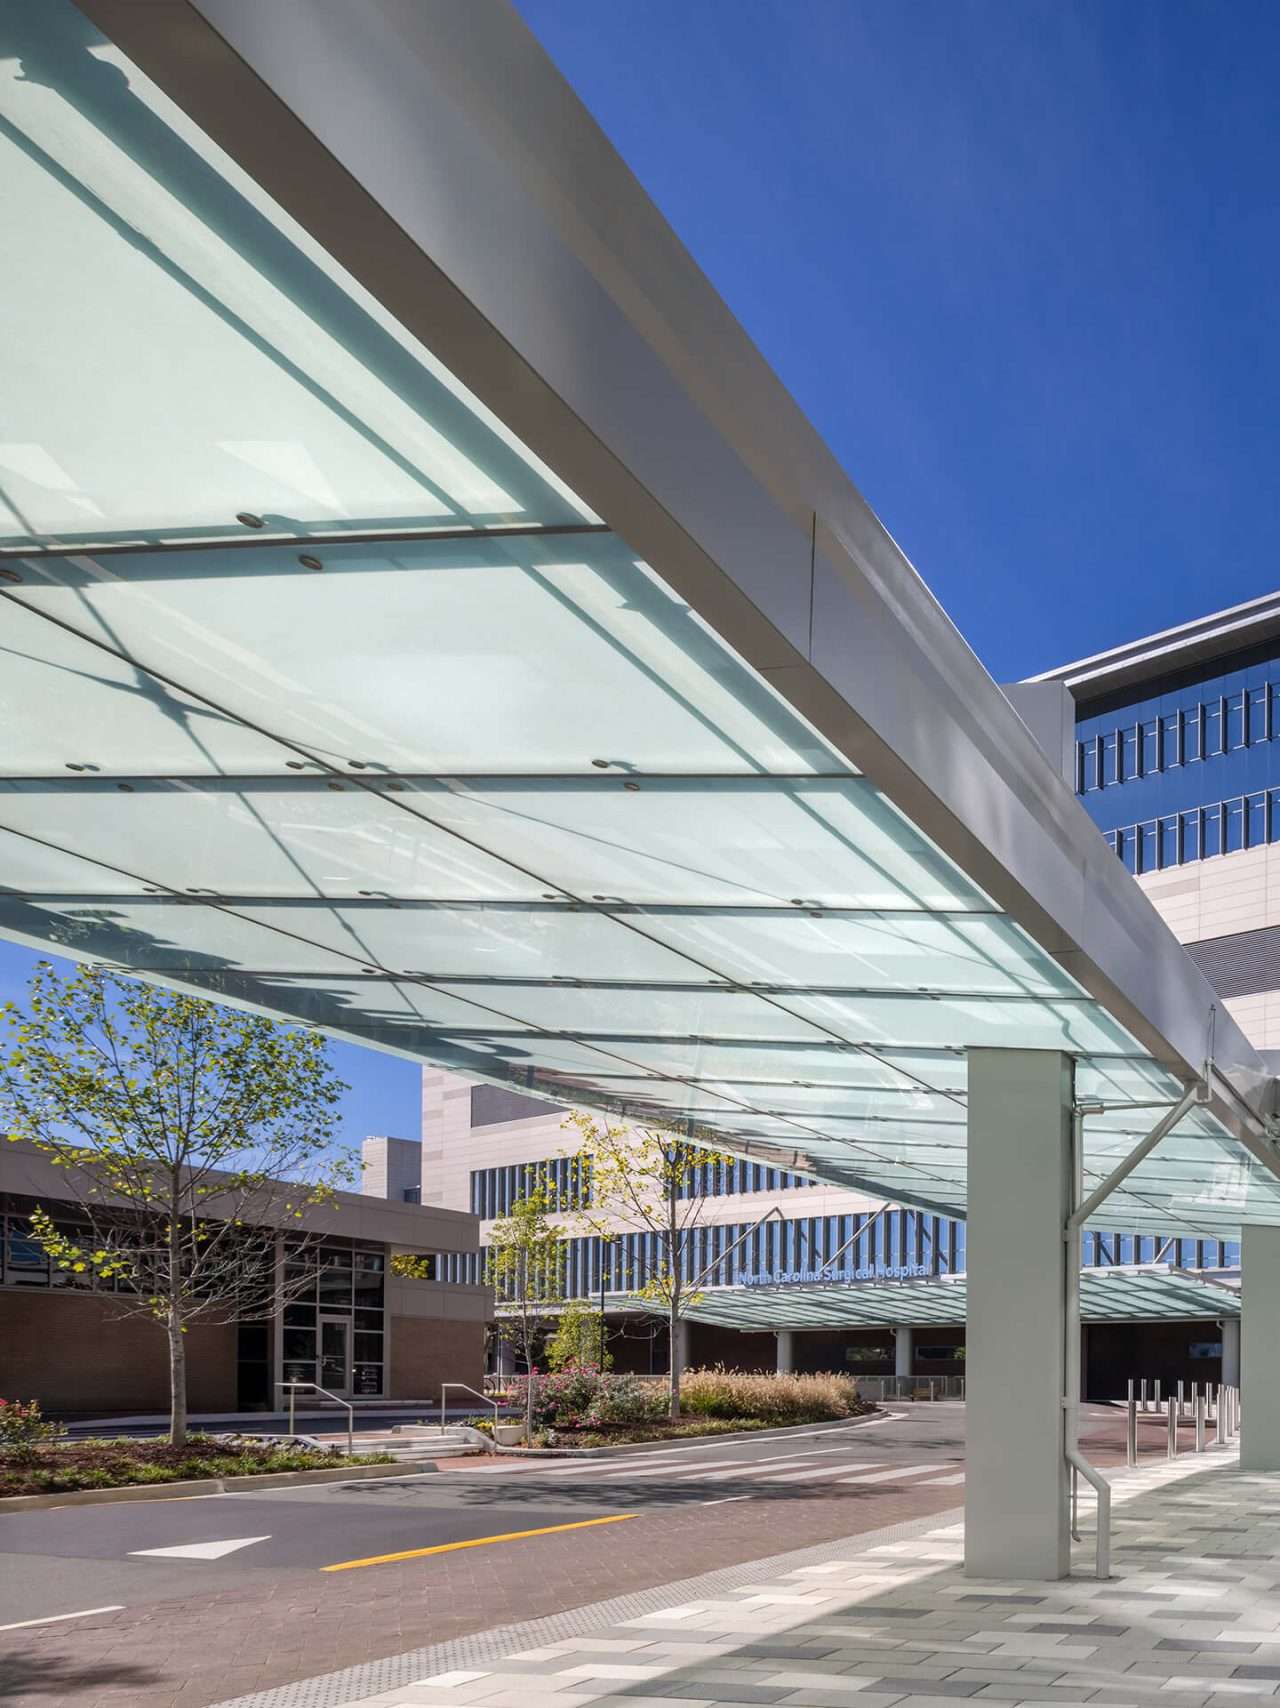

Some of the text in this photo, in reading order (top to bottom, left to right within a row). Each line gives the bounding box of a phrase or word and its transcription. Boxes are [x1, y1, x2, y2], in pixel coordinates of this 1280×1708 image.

[739, 1270, 772, 1285] North
[773, 1268, 822, 1283] Carolina
[823, 1264, 874, 1283] Surgical
